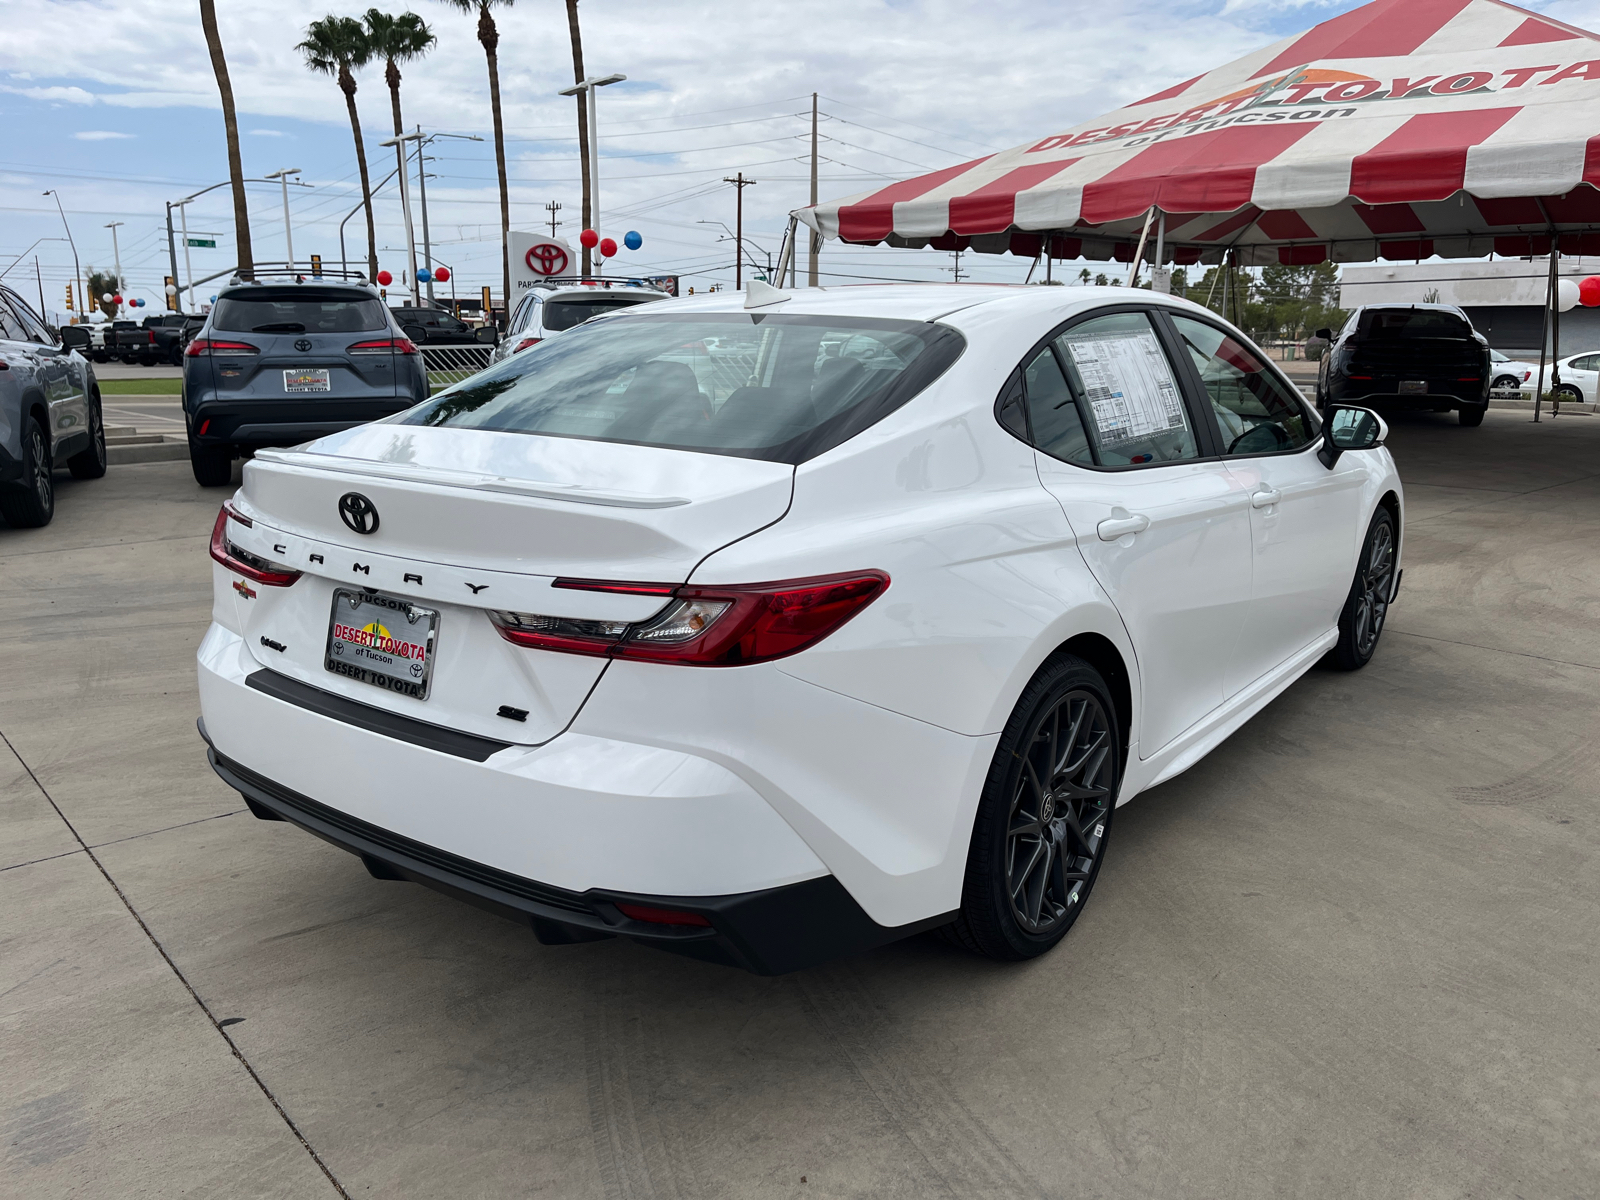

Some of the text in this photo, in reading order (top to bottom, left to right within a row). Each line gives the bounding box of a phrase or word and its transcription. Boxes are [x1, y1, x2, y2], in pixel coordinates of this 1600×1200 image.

[1023, 59, 1600, 154] DESERT TOYOTA
[1122, 108, 1357, 148] of Tucson
[273, 543, 490, 595] CAMRY
[358, 592, 408, 612] TUCSON
[334, 623, 425, 662] DESERT TOYOTA
[355, 647, 393, 665] of Tucson
[328, 660, 418, 697] DESERT TOYOTA
